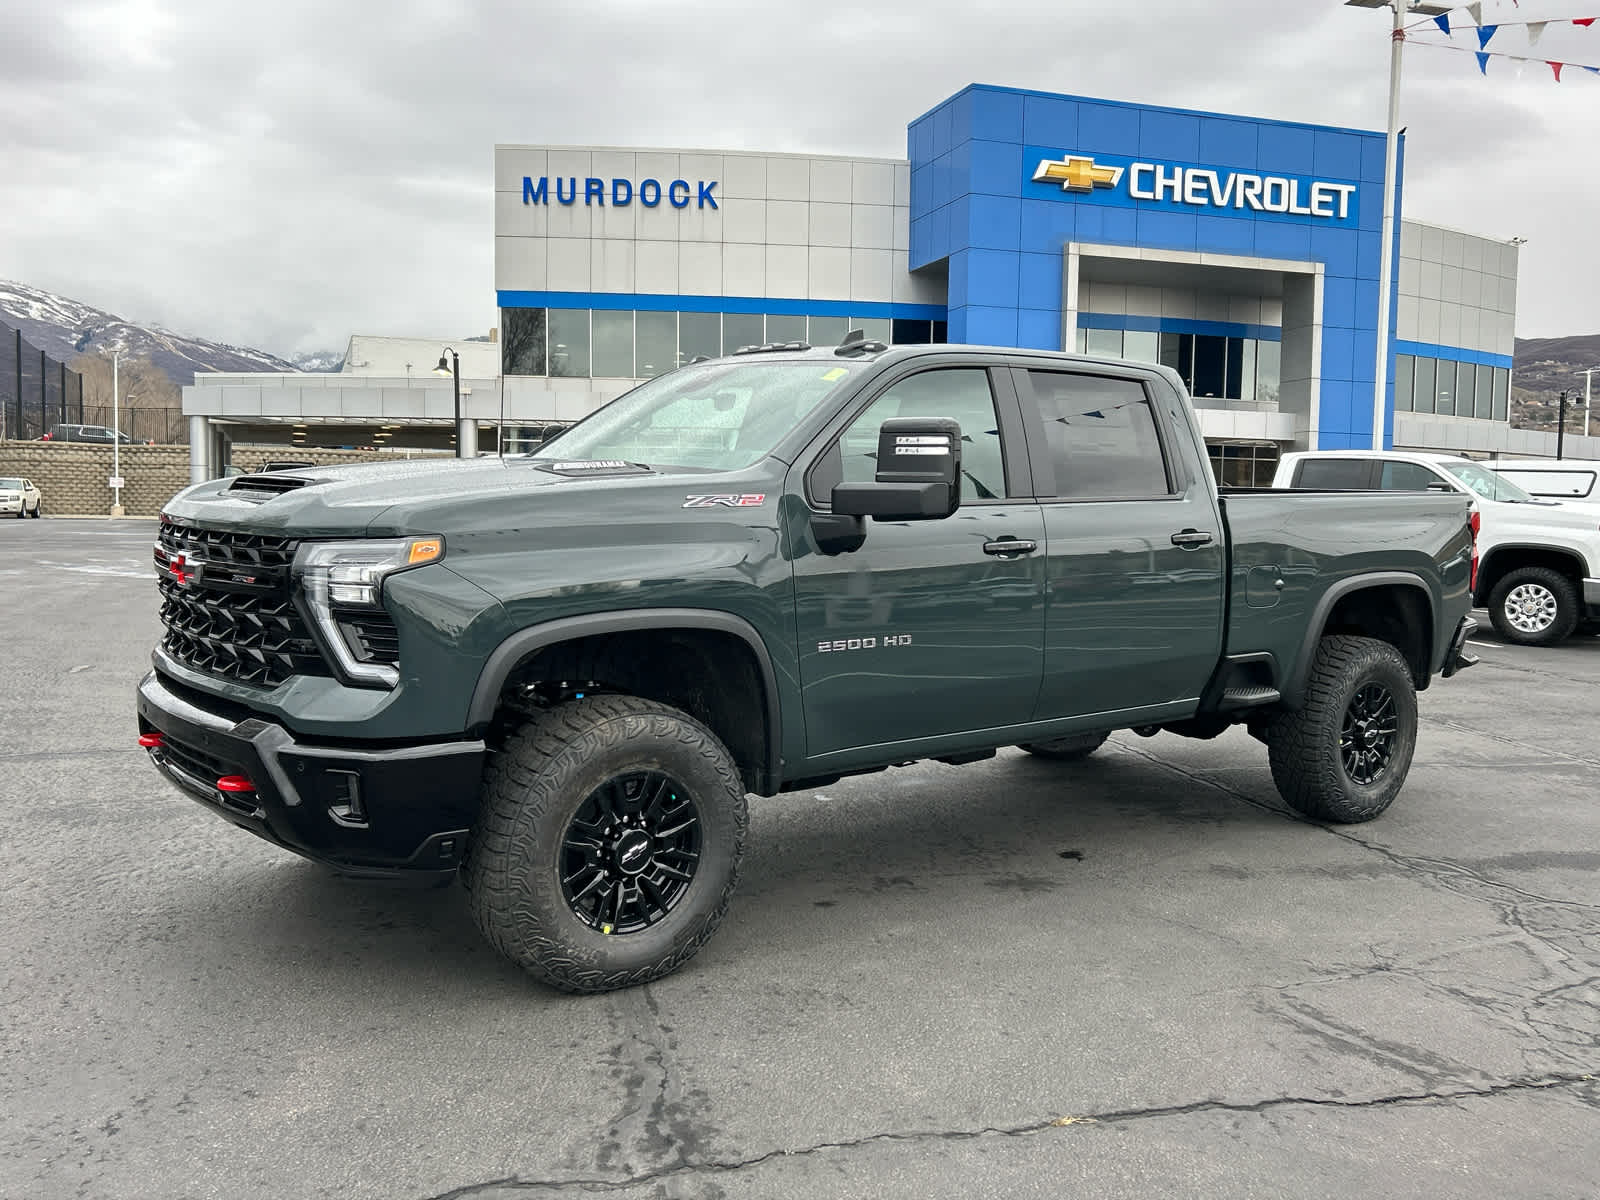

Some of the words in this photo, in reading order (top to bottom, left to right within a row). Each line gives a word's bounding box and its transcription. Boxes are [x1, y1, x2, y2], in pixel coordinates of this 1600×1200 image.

[522, 176, 719, 210] MURDOCK
[1129, 162, 1356, 218] CHEVROLET
[682, 494, 766, 508] ZR2
[817, 637, 877, 653] 2500
[883, 634, 912, 647] HD
